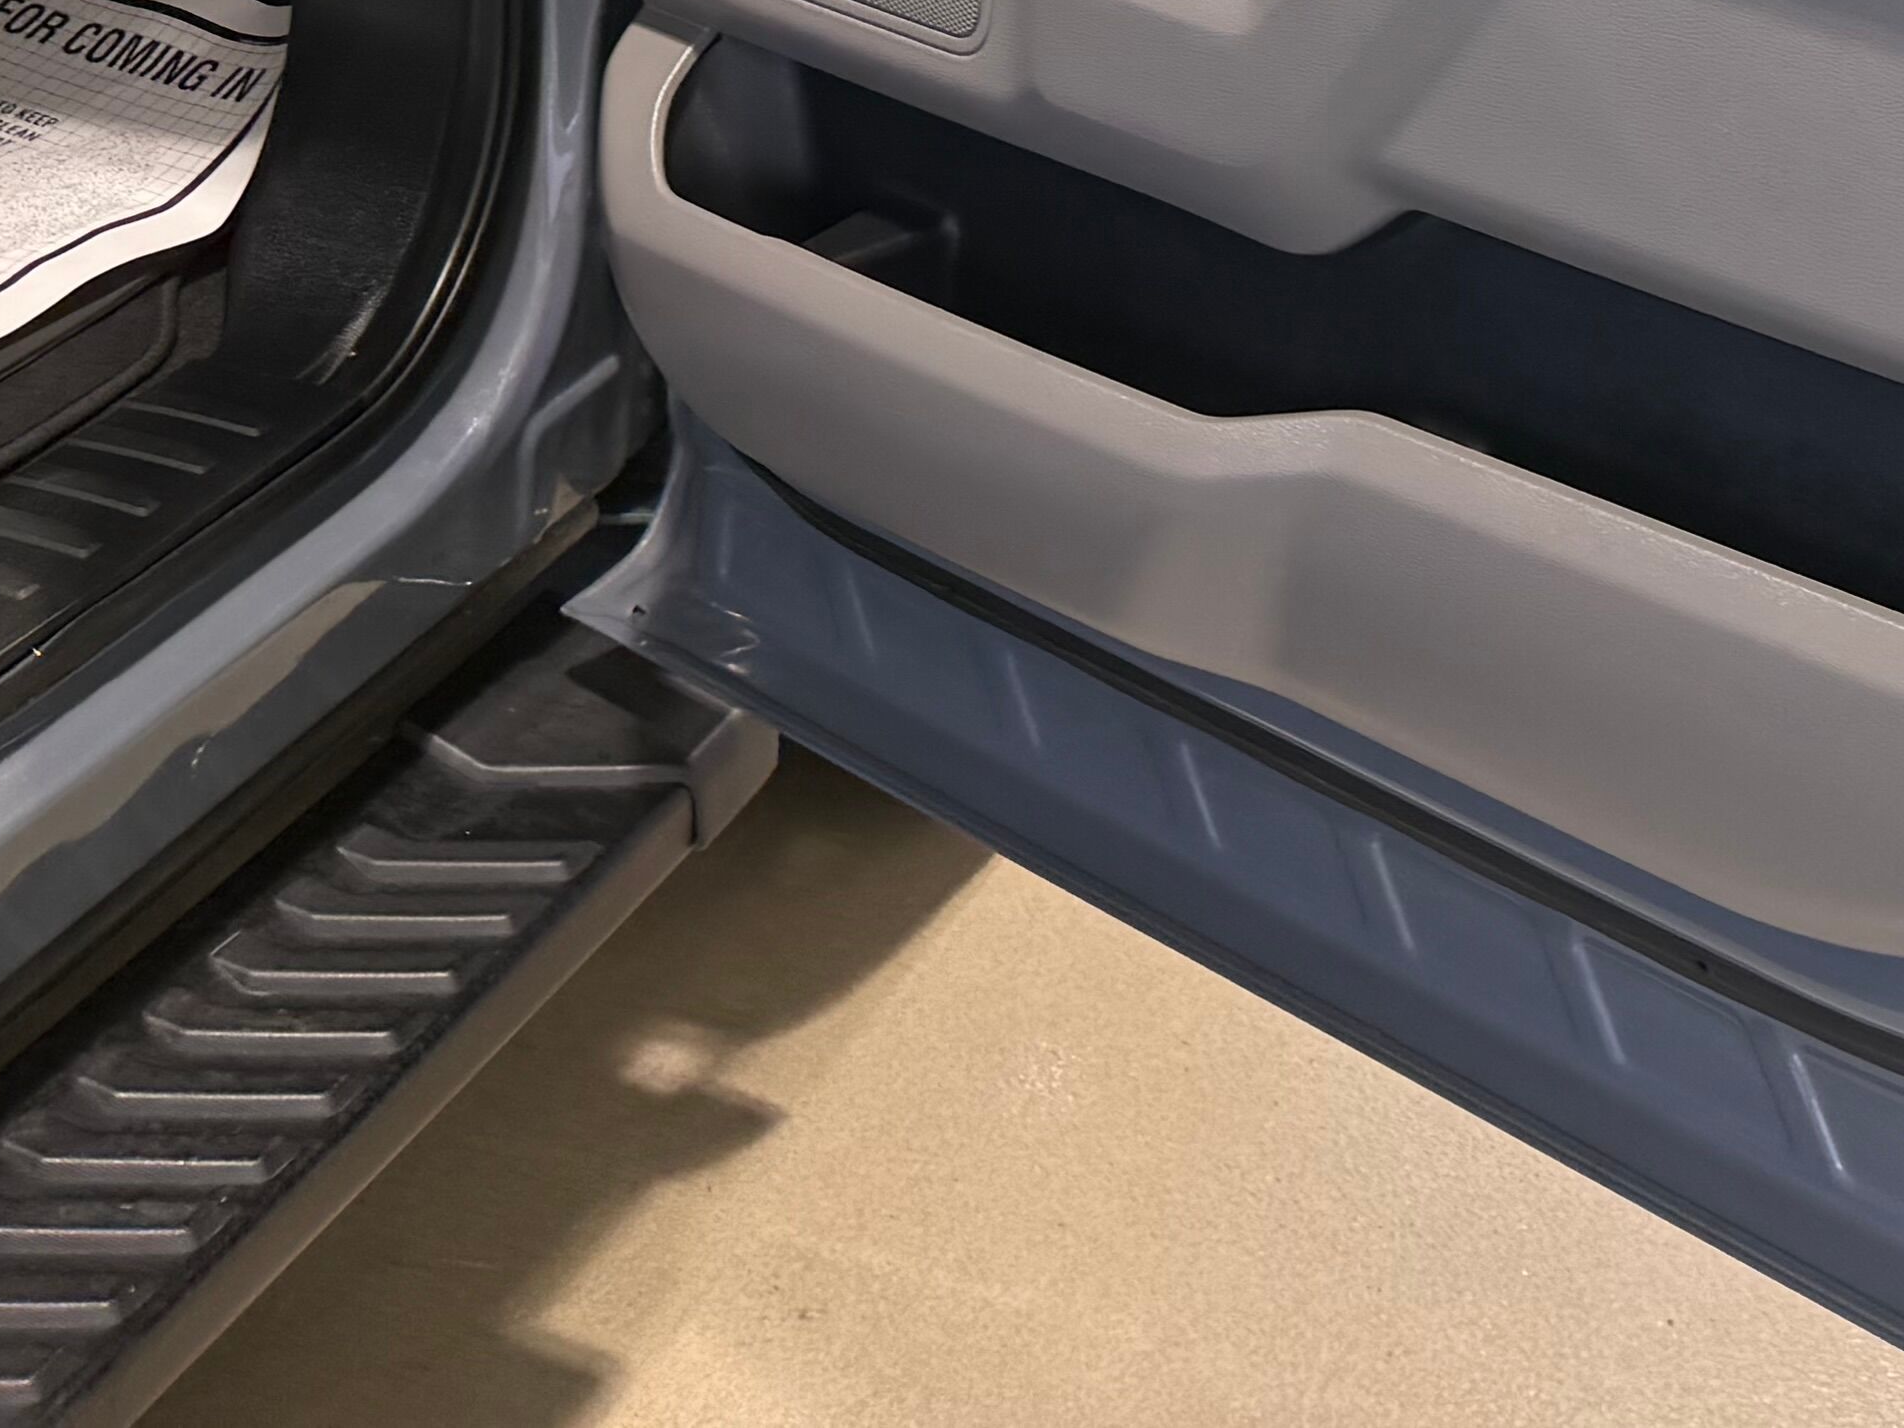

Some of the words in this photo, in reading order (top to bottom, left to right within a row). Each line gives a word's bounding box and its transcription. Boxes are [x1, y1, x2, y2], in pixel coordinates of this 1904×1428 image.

[62, 22, 219, 92] COMING
[210, 66, 267, 103] IN
[14, 107, 59, 128] KEEP
